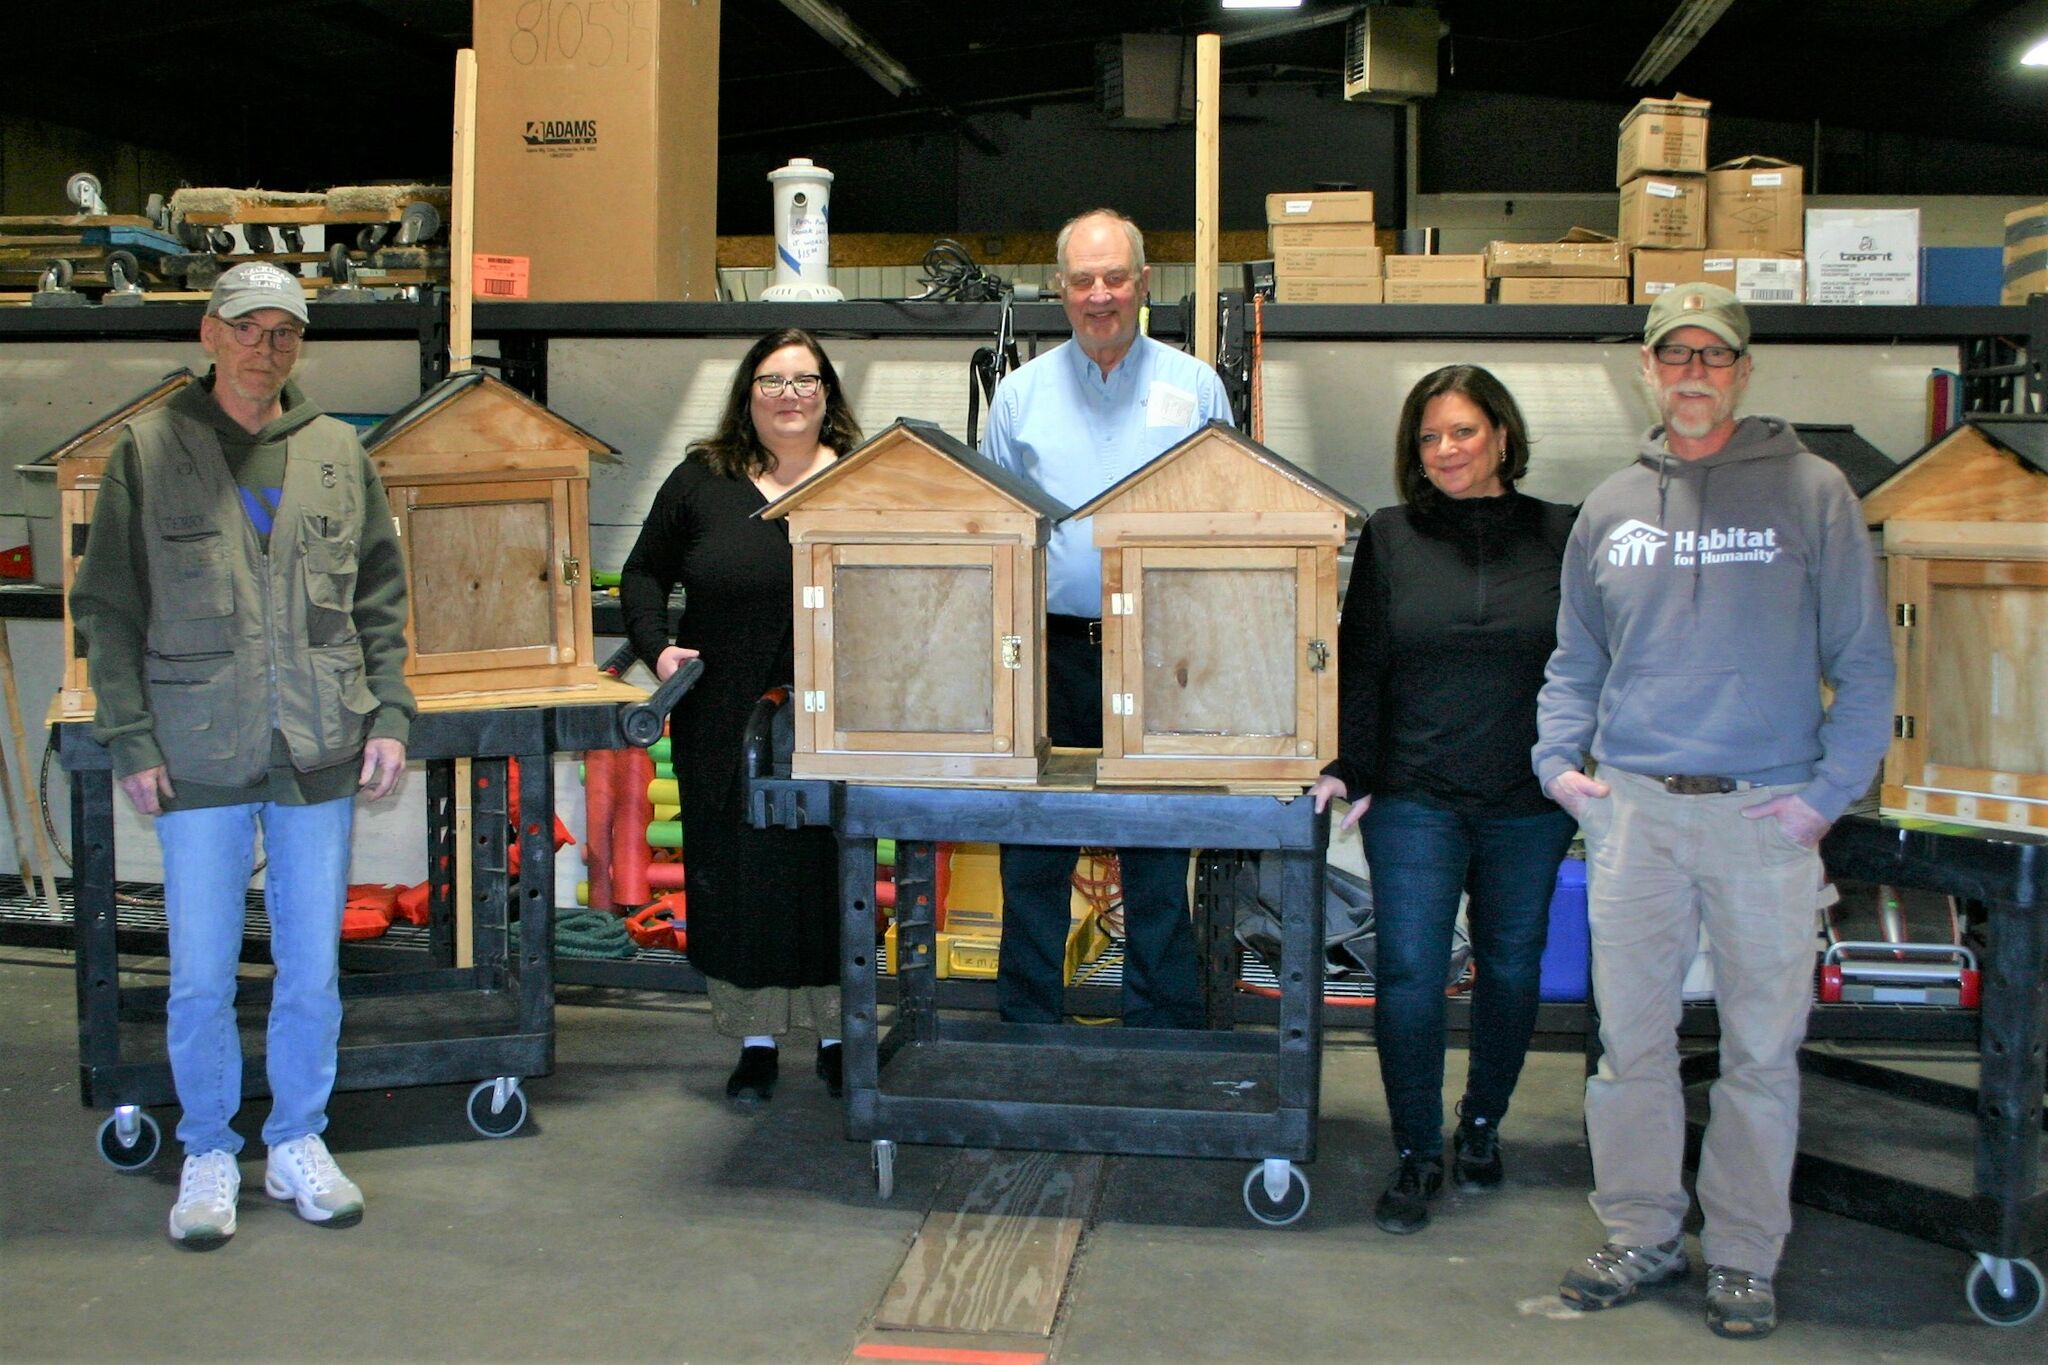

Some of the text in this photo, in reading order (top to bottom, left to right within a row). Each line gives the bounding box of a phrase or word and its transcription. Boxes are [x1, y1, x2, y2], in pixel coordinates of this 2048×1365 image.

[545, 120, 597, 138] ADAMS
[1840, 252, 1878, 262] tape
[1675, 527, 1775, 551] Habitat
[1701, 549, 1775, 563] Humanity
